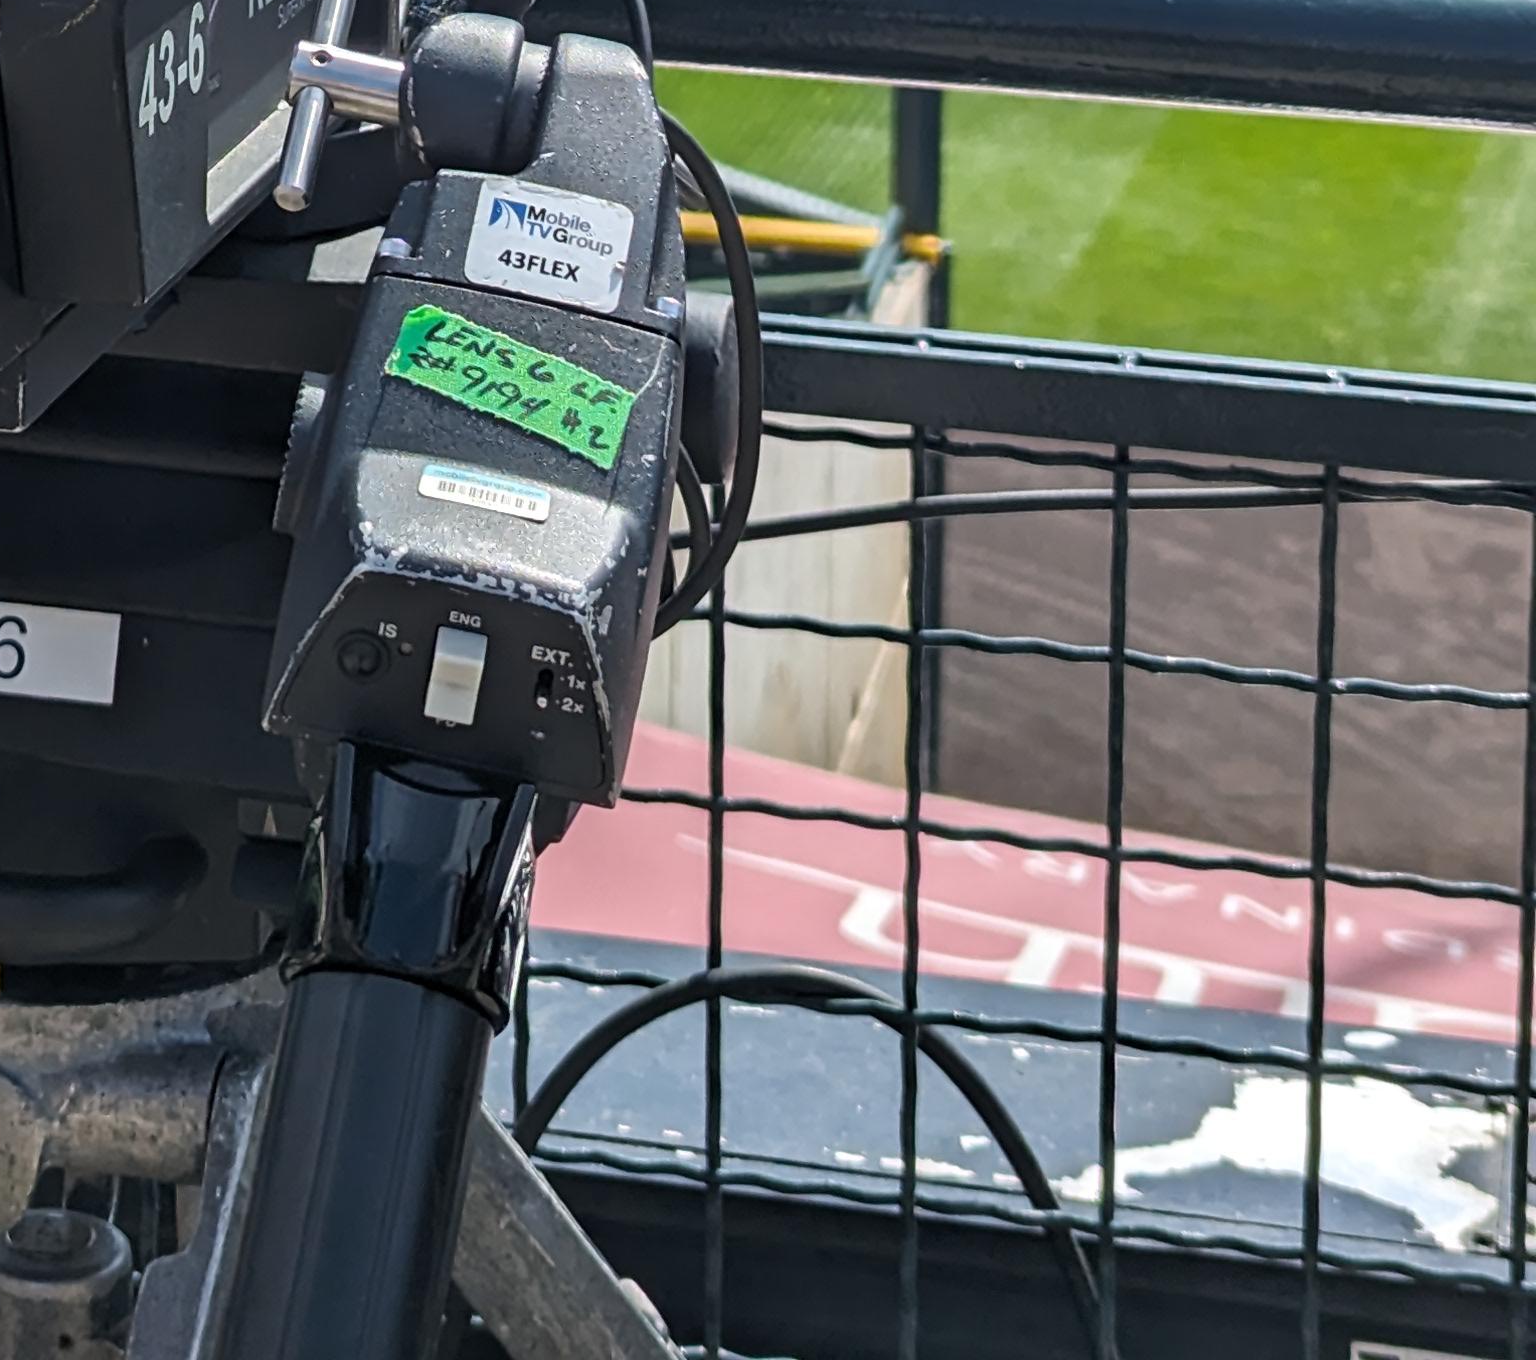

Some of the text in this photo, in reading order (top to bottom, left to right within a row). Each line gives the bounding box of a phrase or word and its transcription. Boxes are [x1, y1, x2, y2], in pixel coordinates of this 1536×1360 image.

[138, 1, 205, 138] 43-6
[527, 204, 592, 233] Mobile
[525, 220, 614, 257] TVGroup
[497, 248, 581, 283] 43FLEX
[424, 320, 517, 370] LENS
[377, 610, 482, 639] IS ENG
[530, 644, 574, 668] EXT.
[561, 697, 585, 714] 2x
